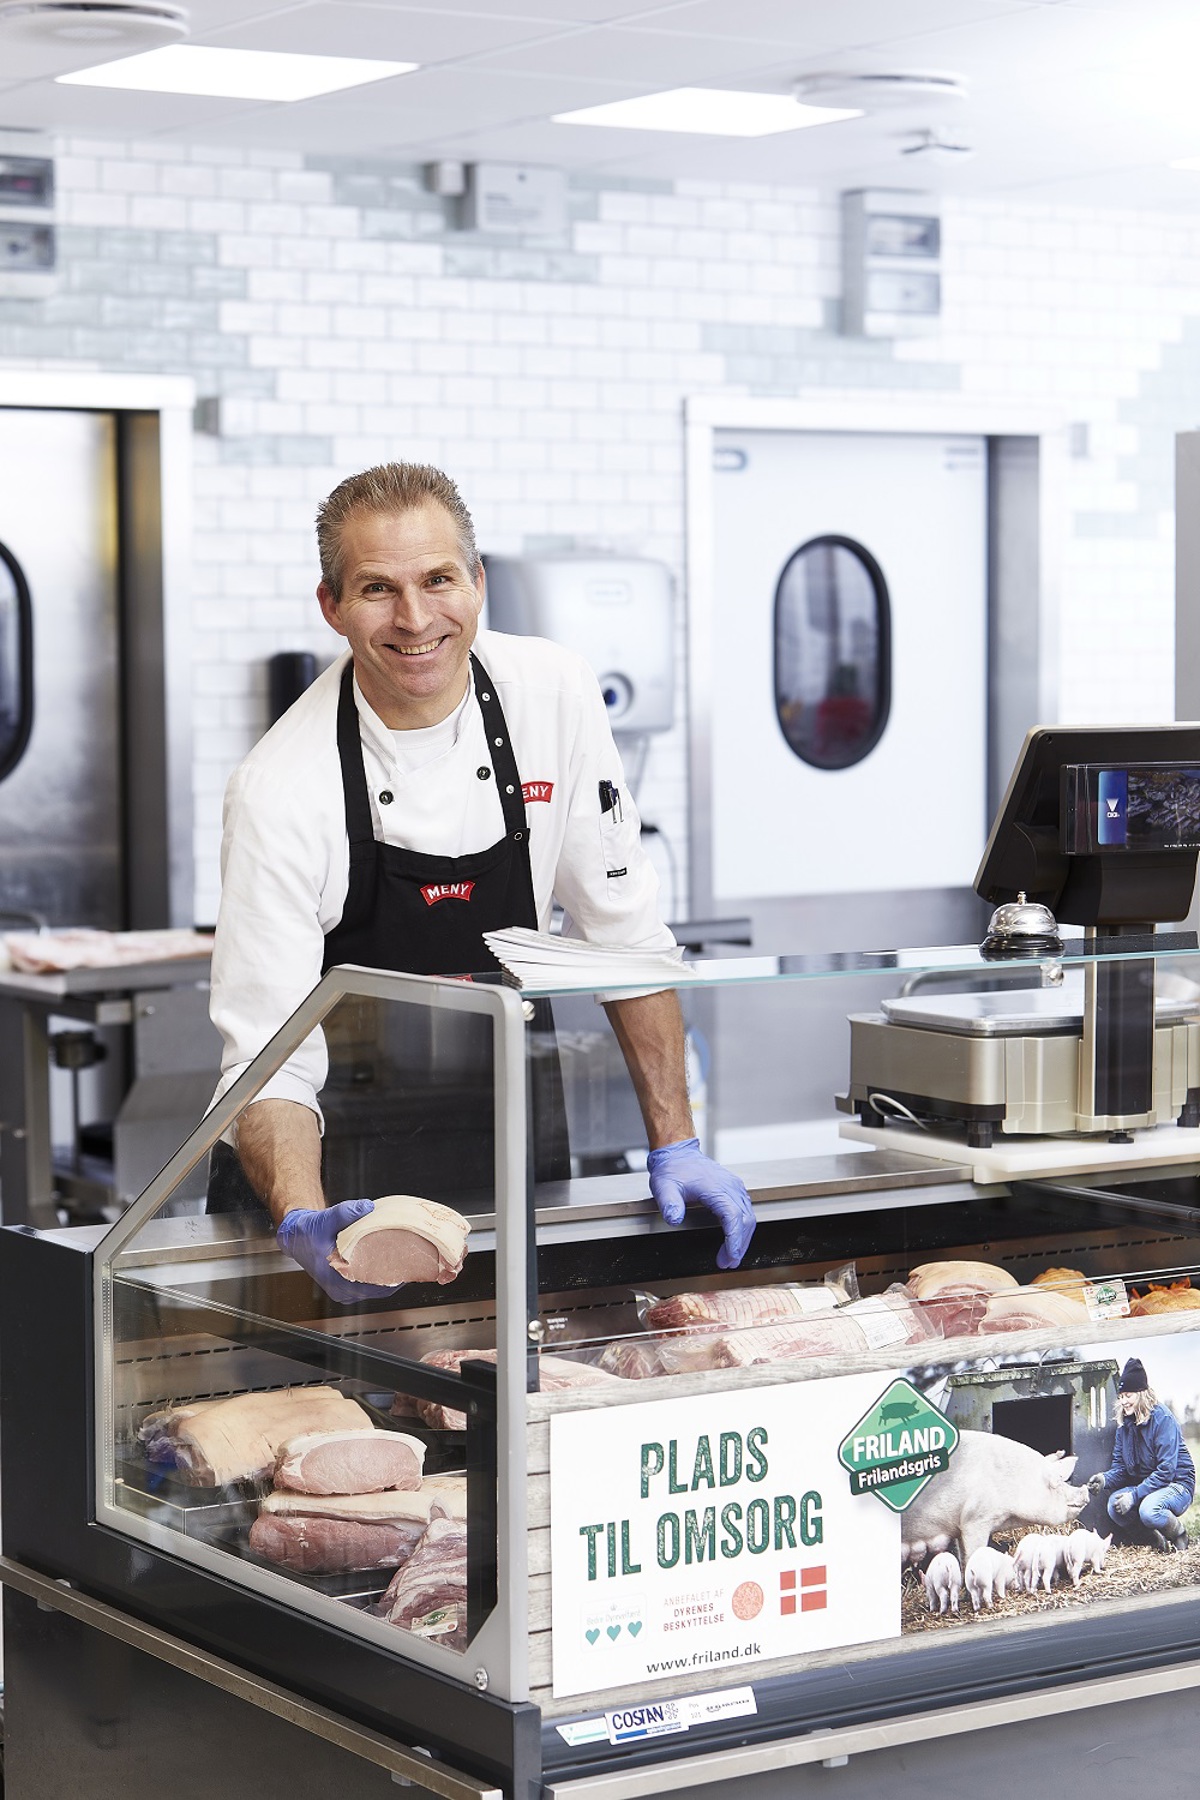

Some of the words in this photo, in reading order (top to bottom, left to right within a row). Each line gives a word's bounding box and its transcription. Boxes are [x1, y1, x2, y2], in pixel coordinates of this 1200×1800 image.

[522, 785, 549, 799] ENY
[427, 883, 469, 900] MENY
[853, 1426, 946, 1462] FRILAND
[640, 1427, 768, 1499] PLADS
[858, 1454, 941, 1488] Frilandsgris
[579, 1519, 641, 1581] TIL
[656, 1490, 823, 1569] OMSORG
[664, 1590, 710, 1607] ANBEFALET
[714, 1588, 725, 1598] AF
[673, 1603, 714, 1617] DYRENES
[663, 1613, 725, 1632] BESKYTTELSE
[646, 1642, 761, 1673] www.friland.dk
[612, 1705, 664, 1730] COSTAN
